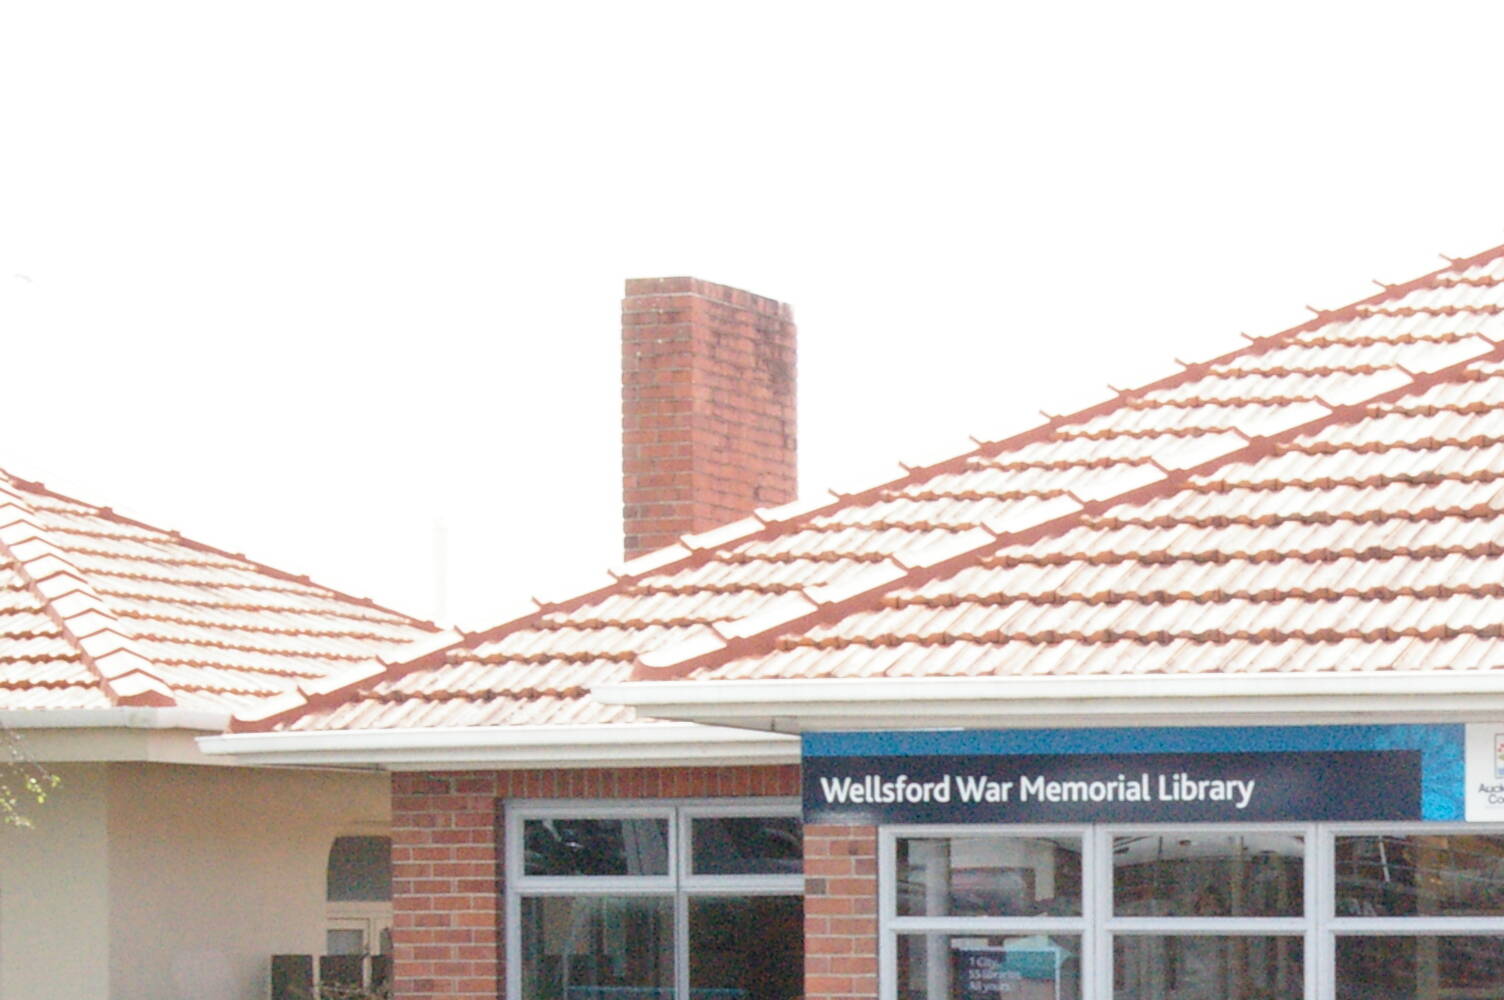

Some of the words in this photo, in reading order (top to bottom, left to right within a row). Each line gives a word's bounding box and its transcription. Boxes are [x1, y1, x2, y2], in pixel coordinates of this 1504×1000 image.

[820, 774, 951, 803] Wellsford
[955, 775, 1014, 803] War
[1019, 773, 1151, 802] Memorial
[1158, 773, 1255, 809] Library
